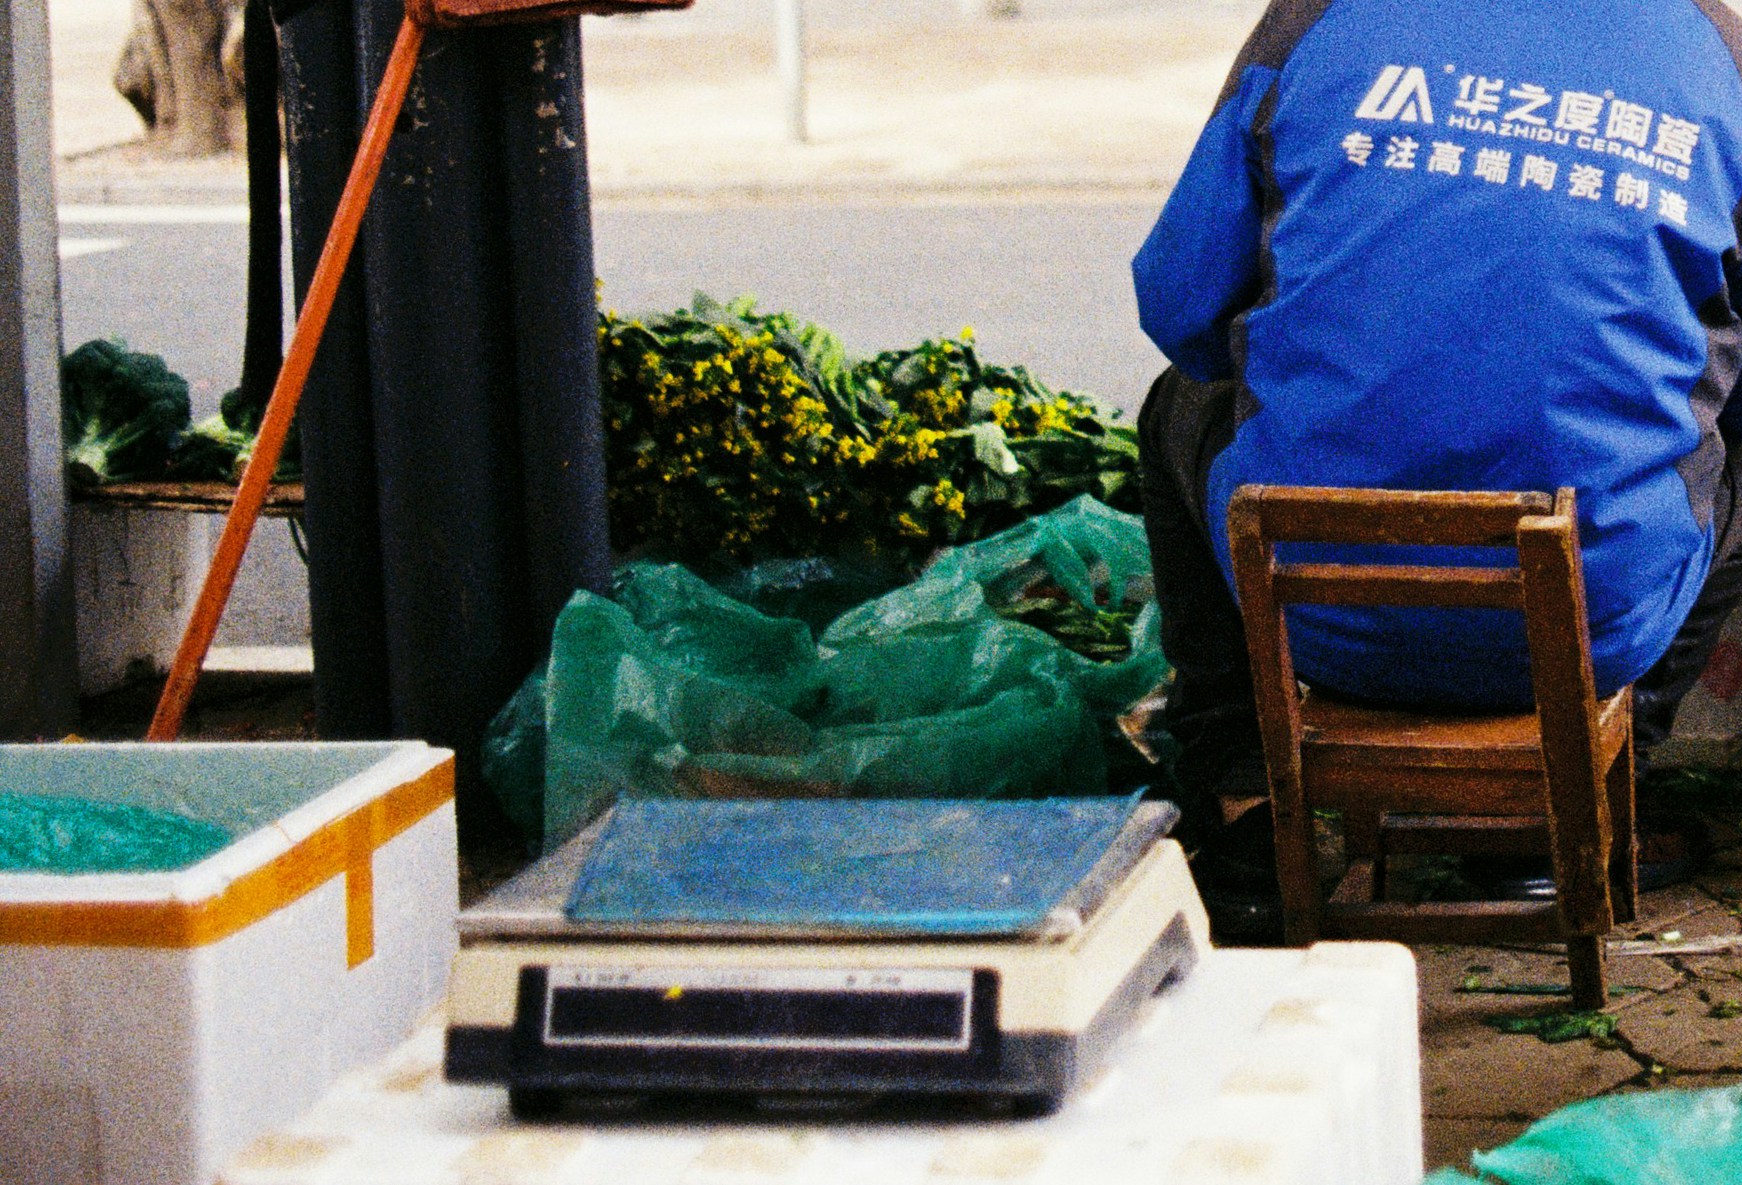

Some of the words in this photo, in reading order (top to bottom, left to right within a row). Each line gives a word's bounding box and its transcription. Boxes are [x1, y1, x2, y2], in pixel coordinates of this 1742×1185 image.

[1341, 130, 1690, 227] 专注高端陶瓷制造
[1447, 113, 1570, 146] HUAZHIDU
[1576, 134, 1691, 181] CERAMICS
